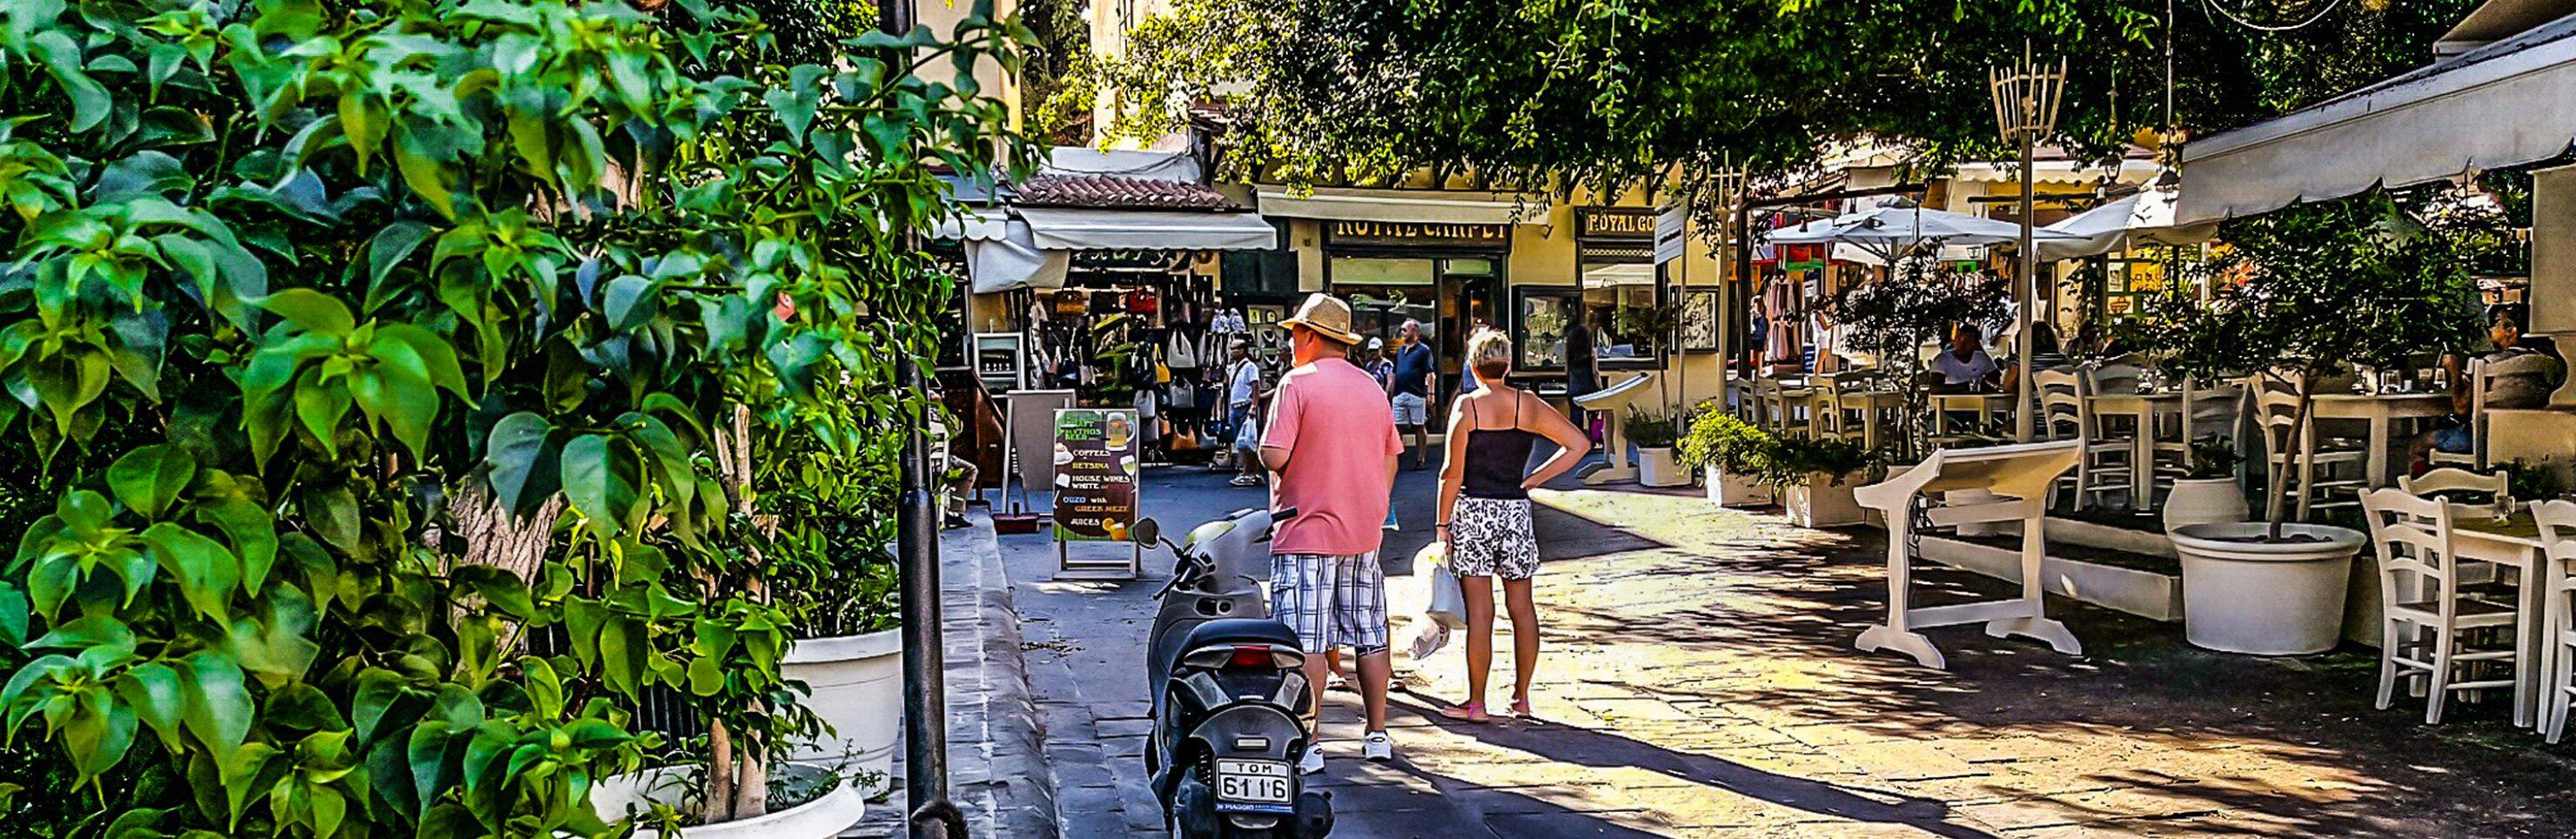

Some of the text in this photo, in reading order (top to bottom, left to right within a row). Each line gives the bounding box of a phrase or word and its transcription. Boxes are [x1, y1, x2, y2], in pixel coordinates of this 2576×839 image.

[1588, 214, 1656, 232] ROYAL GO
[1237, 763, 1272, 774] TOM
[1223, 776, 1286, 799] 6116
